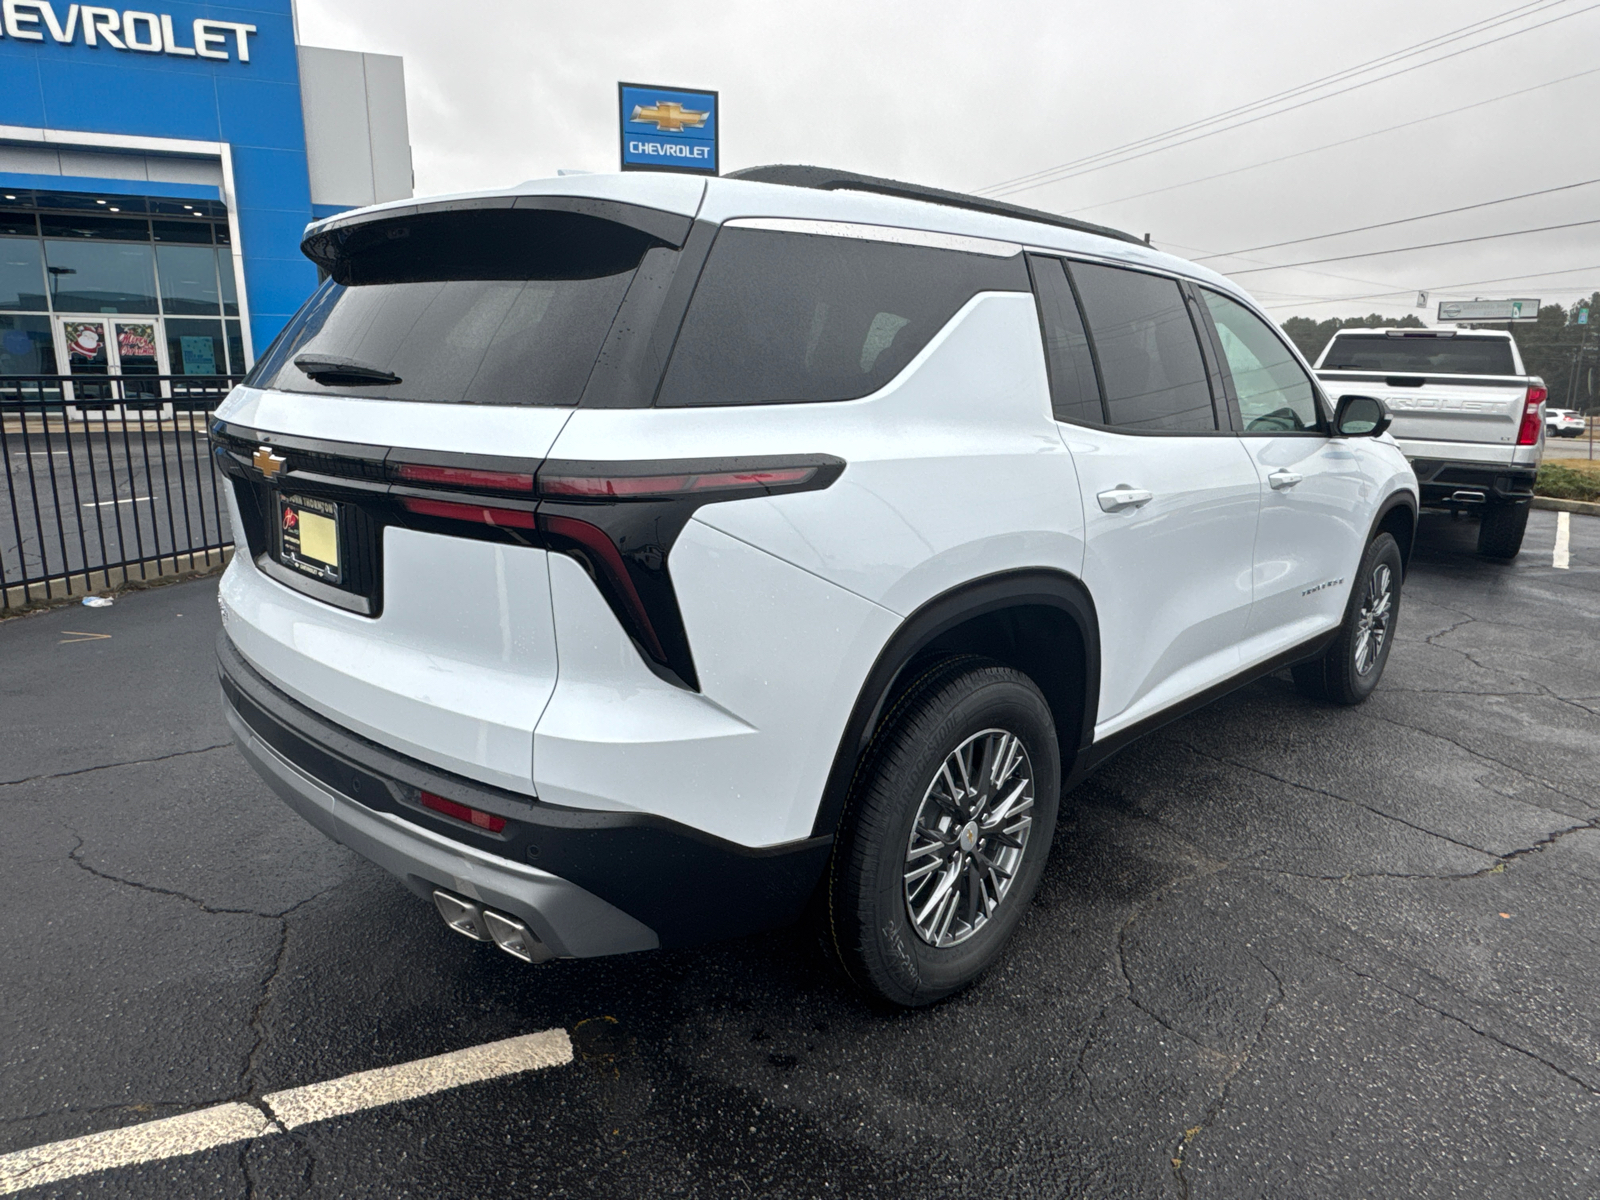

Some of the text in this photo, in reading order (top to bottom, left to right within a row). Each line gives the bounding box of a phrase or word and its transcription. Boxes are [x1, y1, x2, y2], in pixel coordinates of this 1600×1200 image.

[0, 0, 256, 62] EVROLET
[629, 141, 710, 159] CHEVROLET
[118, 332, 148, 347] Merry
